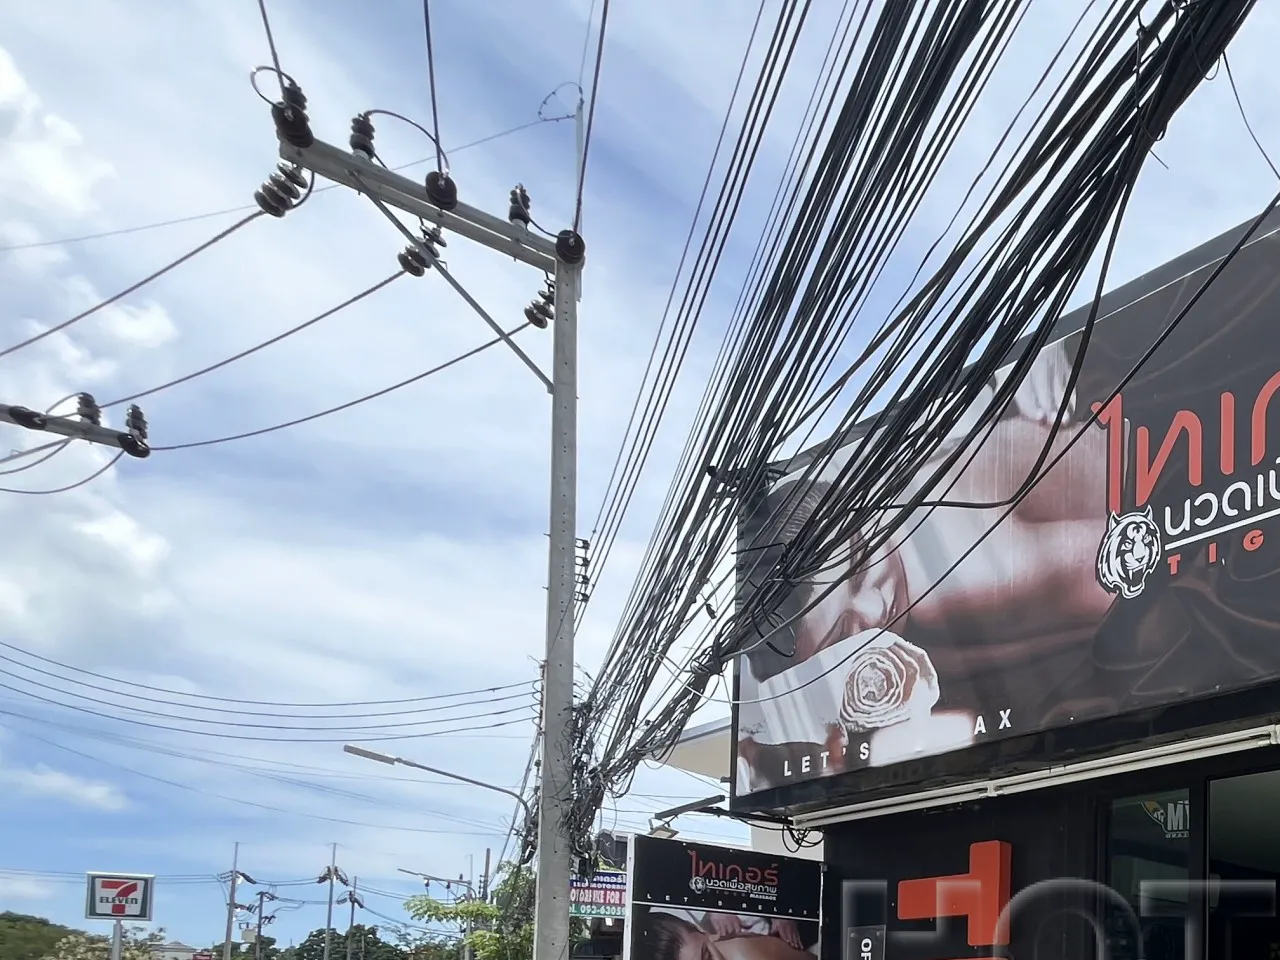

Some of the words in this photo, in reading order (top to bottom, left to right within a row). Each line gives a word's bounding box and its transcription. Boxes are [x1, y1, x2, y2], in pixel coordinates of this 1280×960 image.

[784, 741, 870, 777] LET'S
[688, 851, 779, 887] ไทเกอร์
[570, 888, 605, 903] OTORBIKE
[606, 890, 620, 904] FOR
